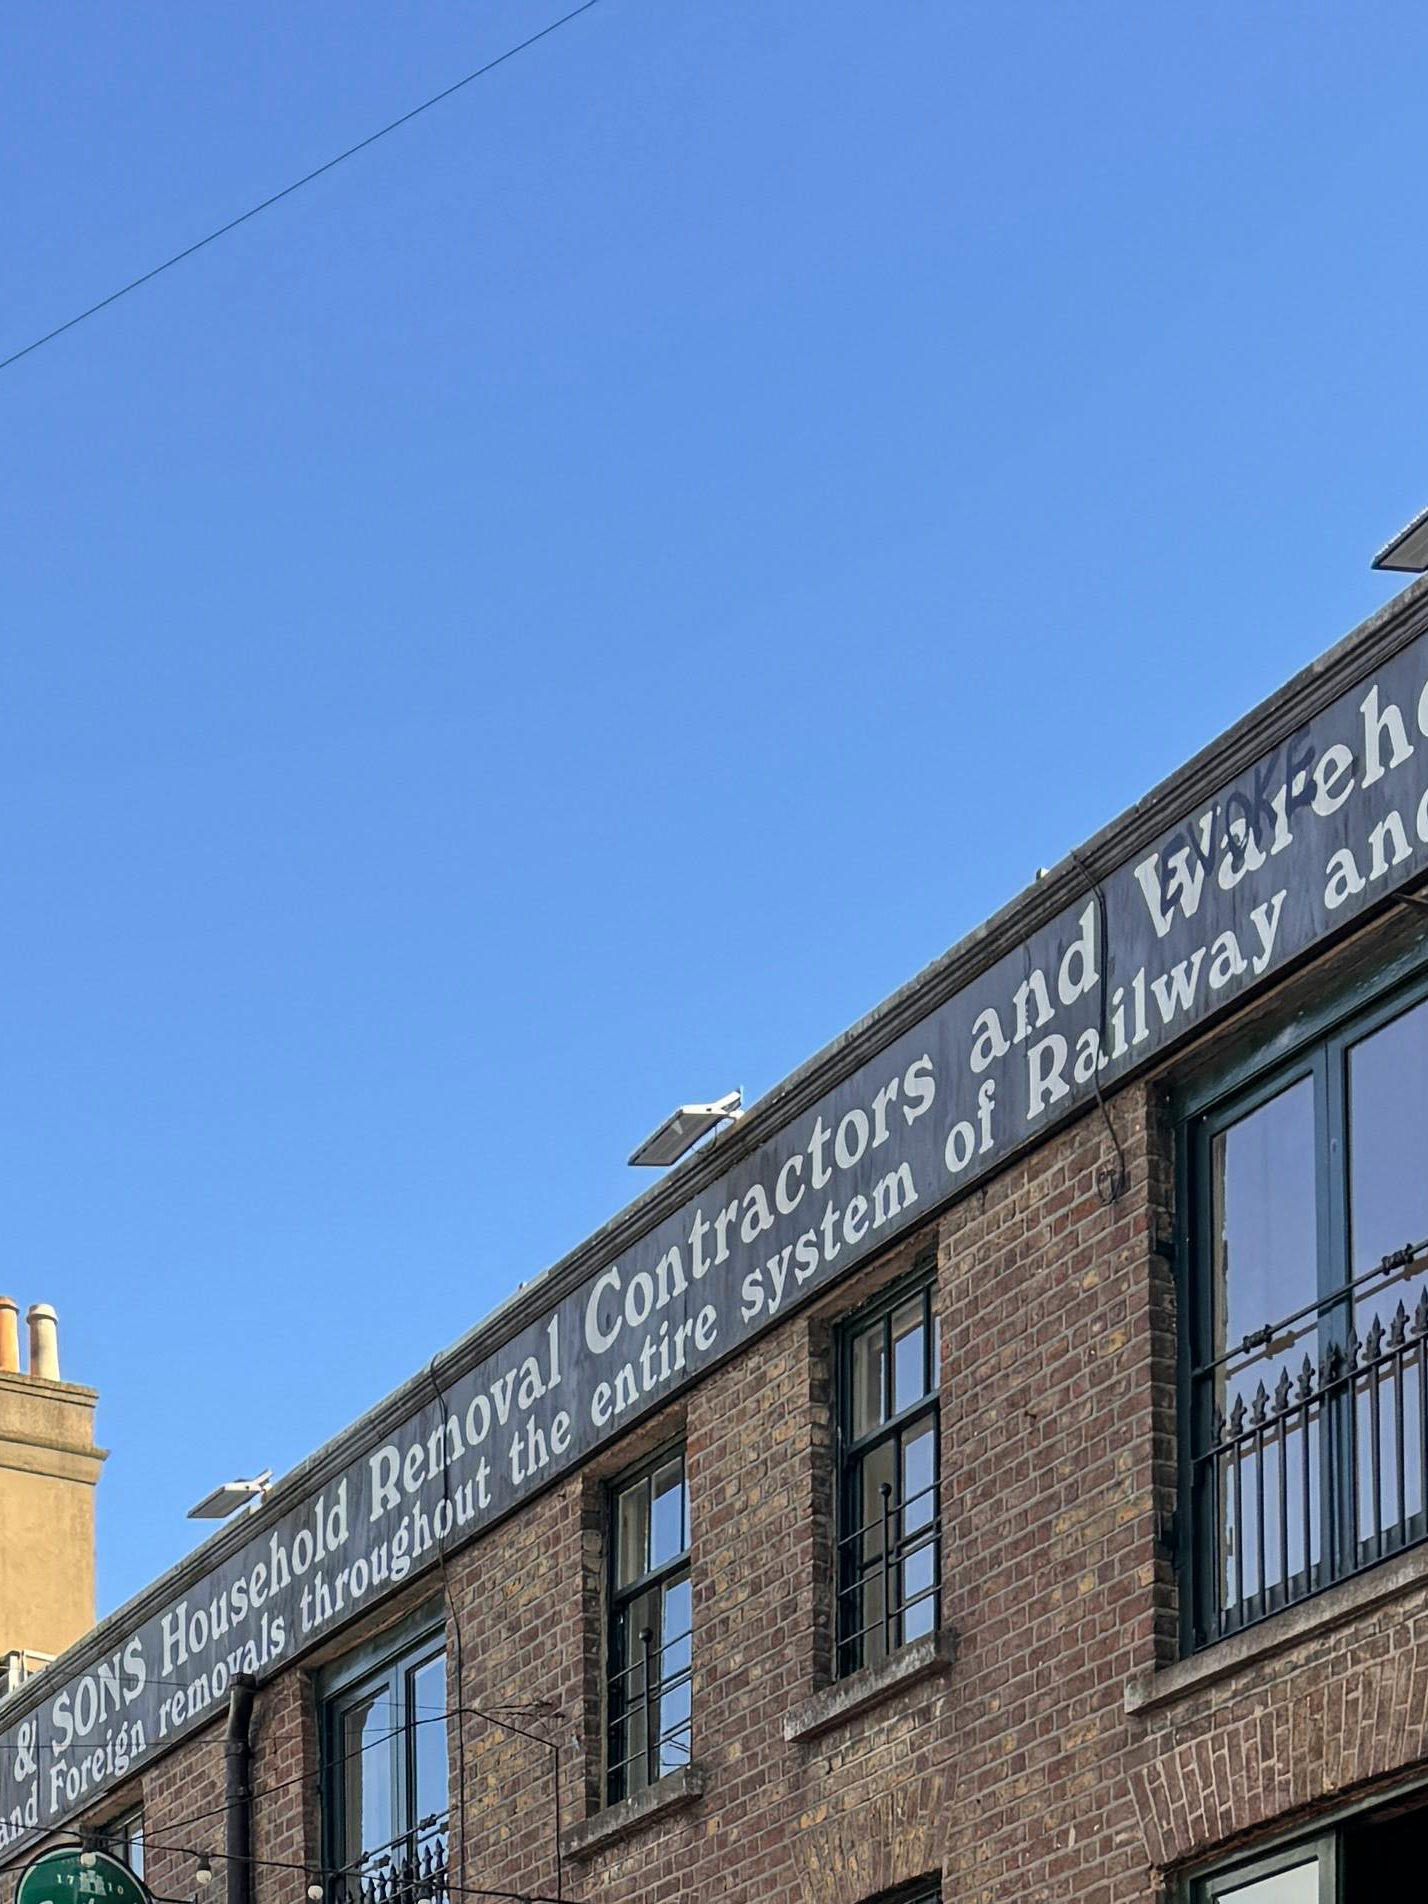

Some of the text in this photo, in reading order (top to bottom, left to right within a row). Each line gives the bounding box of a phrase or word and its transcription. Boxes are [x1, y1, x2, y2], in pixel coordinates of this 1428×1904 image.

[12, 1714, 38, 1782] &
[50, 1637, 147, 1757] SONS
[160, 1477, 348, 1679] Household
[369, 1314, 560, 1523] Removal
[583, 1053, 936, 1355] Contractors
[969, 900, 1103, 1074] and
[49, 1718, 147, 1815] Foreign
[158, 1612, 285, 1738] removals
[299, 1456, 491, 1634] throughout
[508, 1411, 571, 1485] the
[590, 1304, 718, 1427] entire
[740, 1160, 918, 1325] system
[944, 1080, 995, 1173] of
[1025, 889, 1287, 1121] Railway
